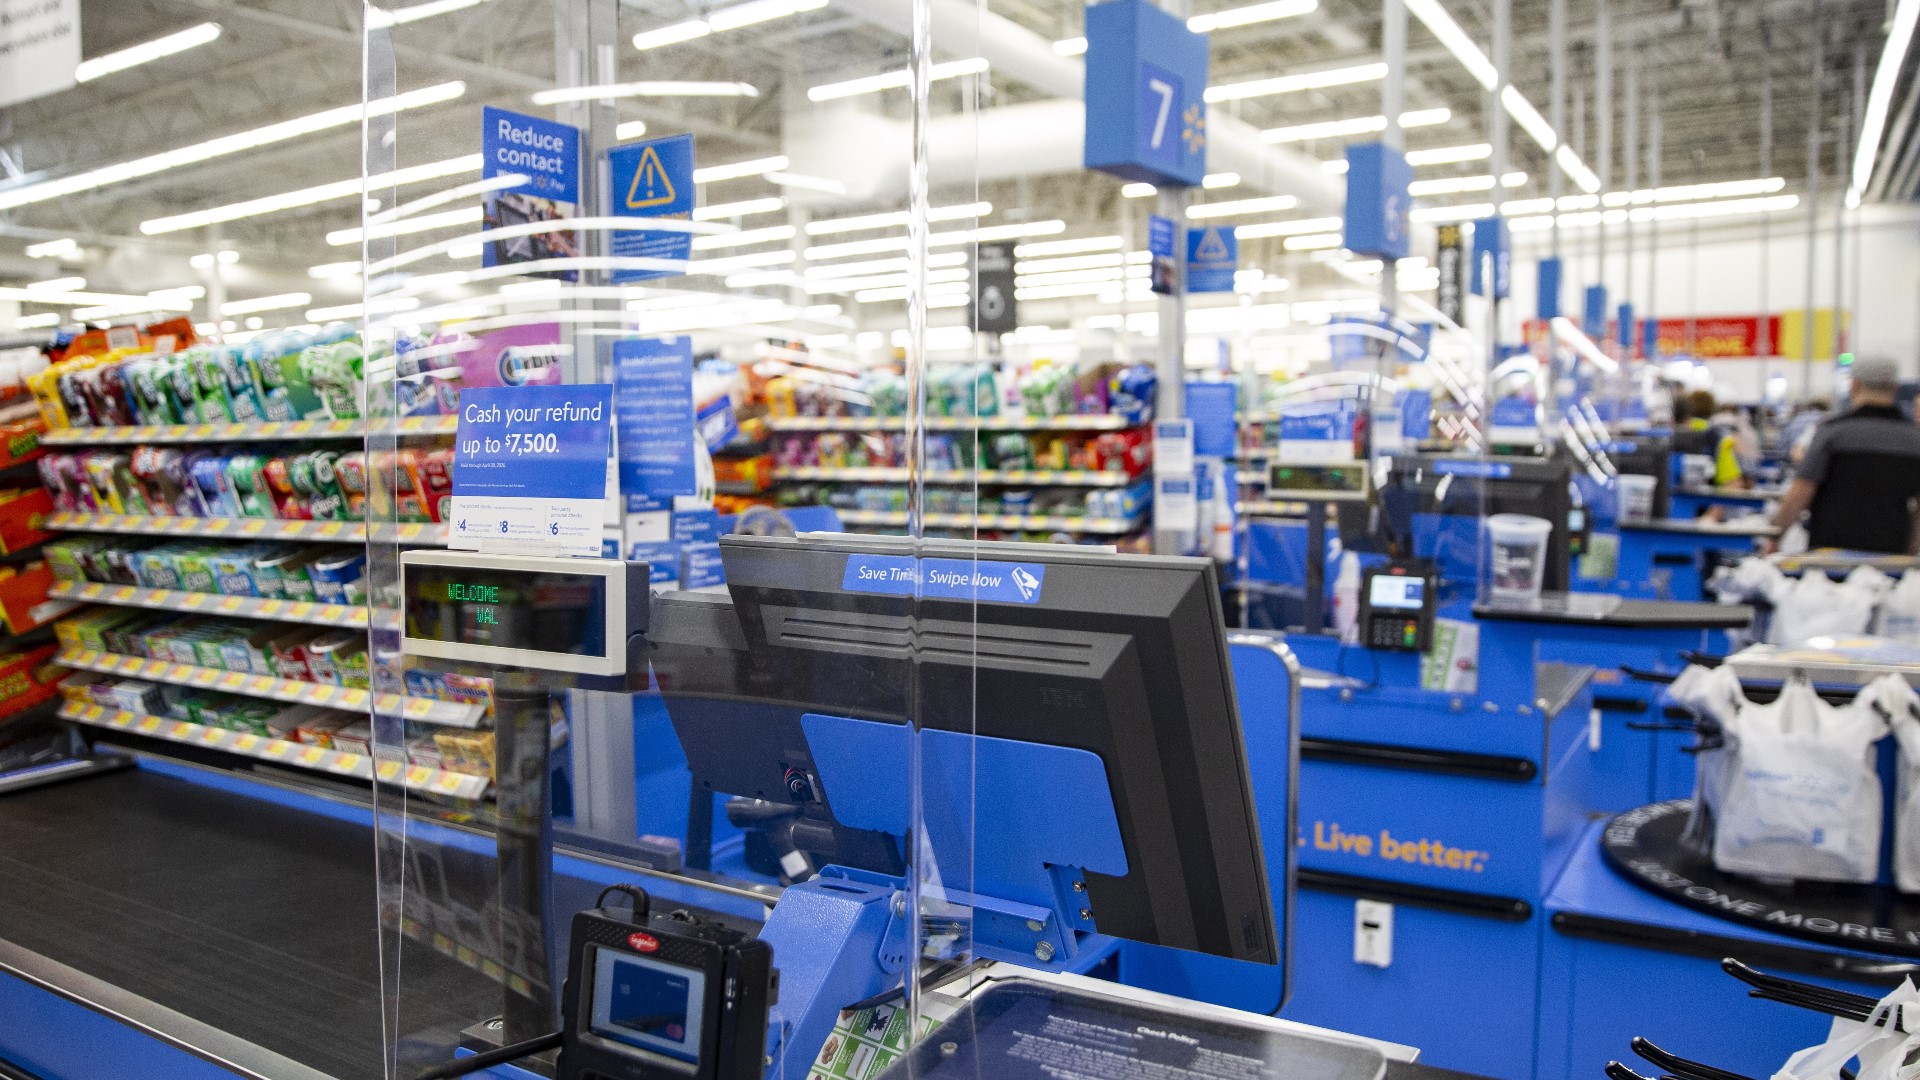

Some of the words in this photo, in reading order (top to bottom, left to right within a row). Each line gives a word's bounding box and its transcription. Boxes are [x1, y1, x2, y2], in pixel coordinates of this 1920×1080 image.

[1149, 79, 1174, 149] 7
[498, 119, 564, 153] Reduce
[497, 145, 564, 175] contact
[465, 403, 500, 424] Cash
[505, 406, 541, 428] your
[545, 401, 602, 423] refund
[463, 438, 480, 459] up
[485, 435, 501, 454] to
[505, 432, 560, 457] $7,500.
[858, 565, 887, 582] Save
[929, 569, 968, 588] Swipe
[447, 583, 499, 603] WELCOME
[476, 607, 499, 625] WAL
[1314, 821, 1373, 856] Live
[1684, 885, 1767, 915] ONE
[1765, 909, 1898, 943] MORE
